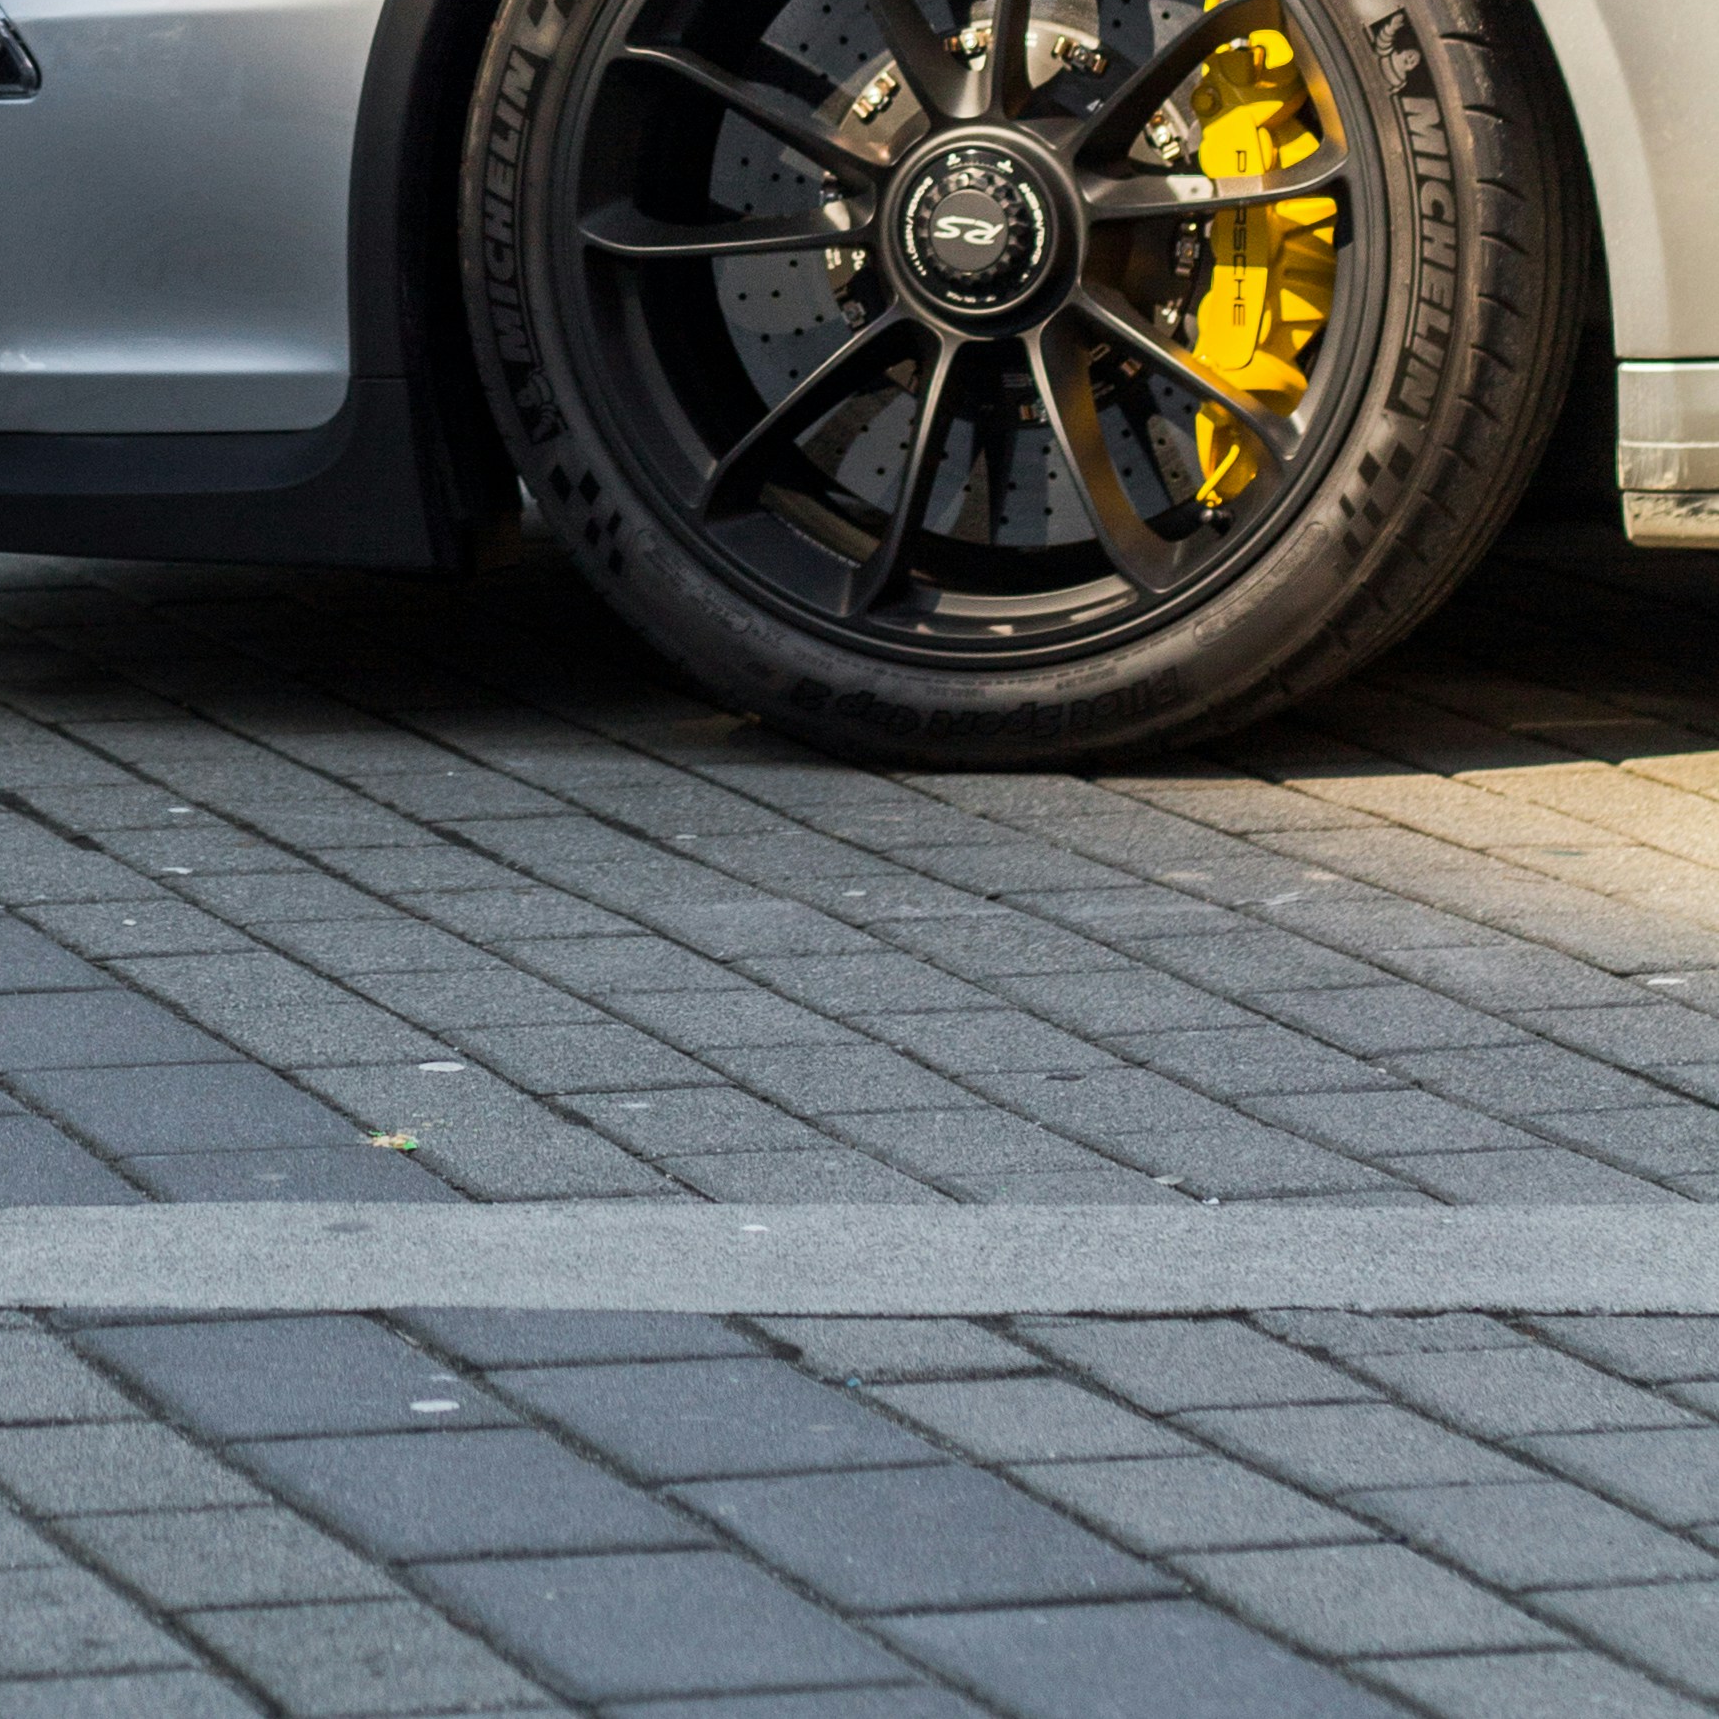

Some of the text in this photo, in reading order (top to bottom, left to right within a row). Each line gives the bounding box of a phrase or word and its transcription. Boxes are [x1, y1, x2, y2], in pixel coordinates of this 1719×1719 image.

[486, 50, 538, 364] MICHELIN
[933, 215, 1005, 245] RS
[1233, 150, 1247, 326] PRSCHE
[1398, 95, 1457, 419] MICHELIN
